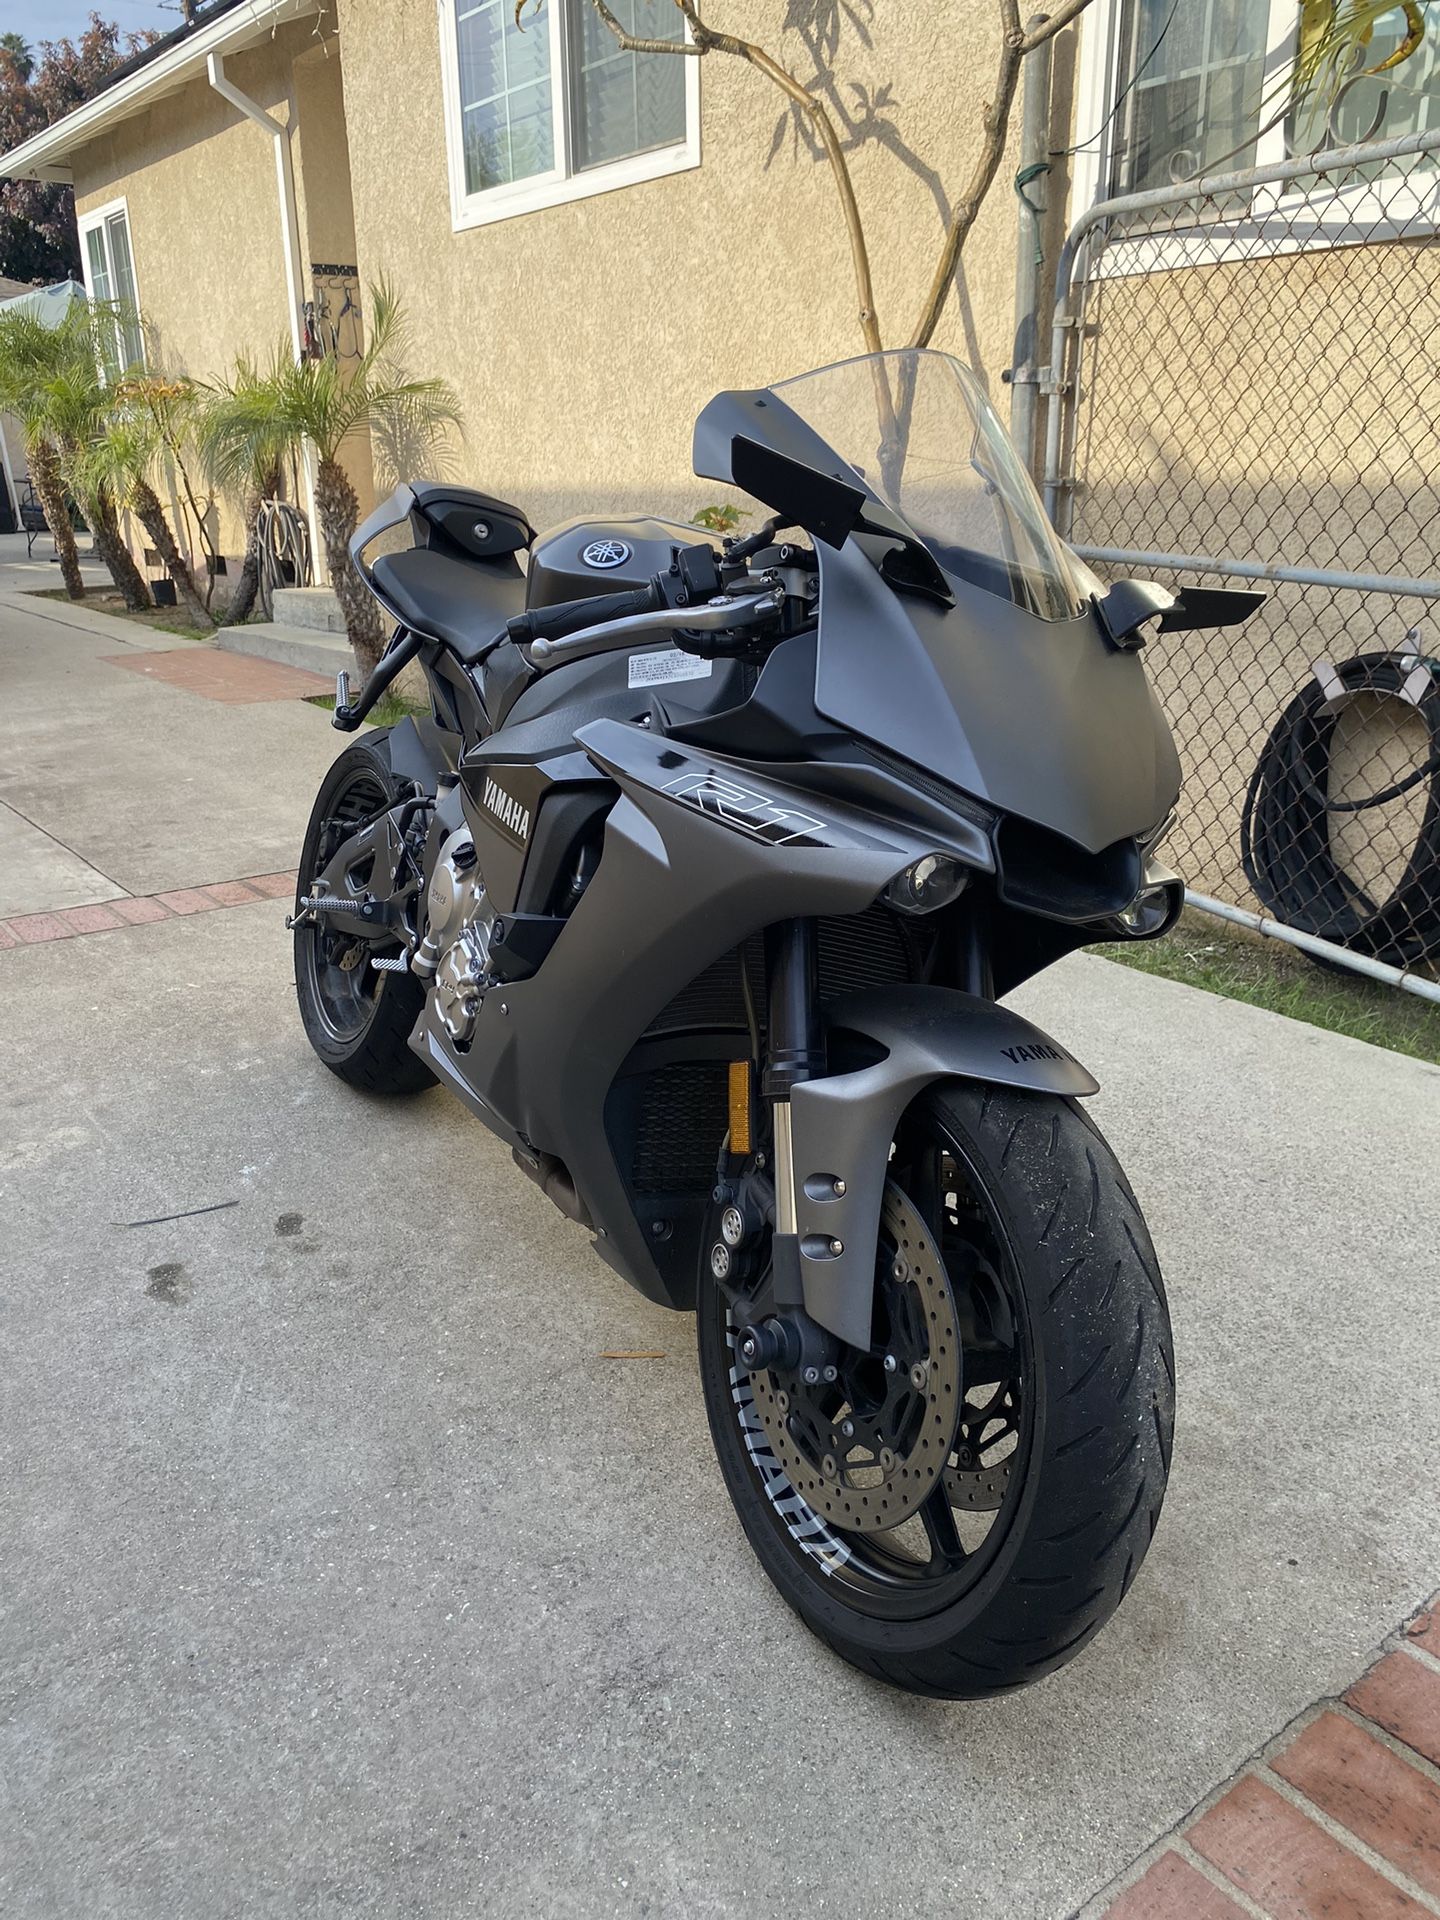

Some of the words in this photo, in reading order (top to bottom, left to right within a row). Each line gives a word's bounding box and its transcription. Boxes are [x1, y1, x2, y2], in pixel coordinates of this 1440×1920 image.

[483, 776, 530, 839] YAMAHA
[660, 773, 828, 844] R1
[1000, 1044, 1079, 1064] YAMA
[726, 1308, 852, 1577] MAHA
